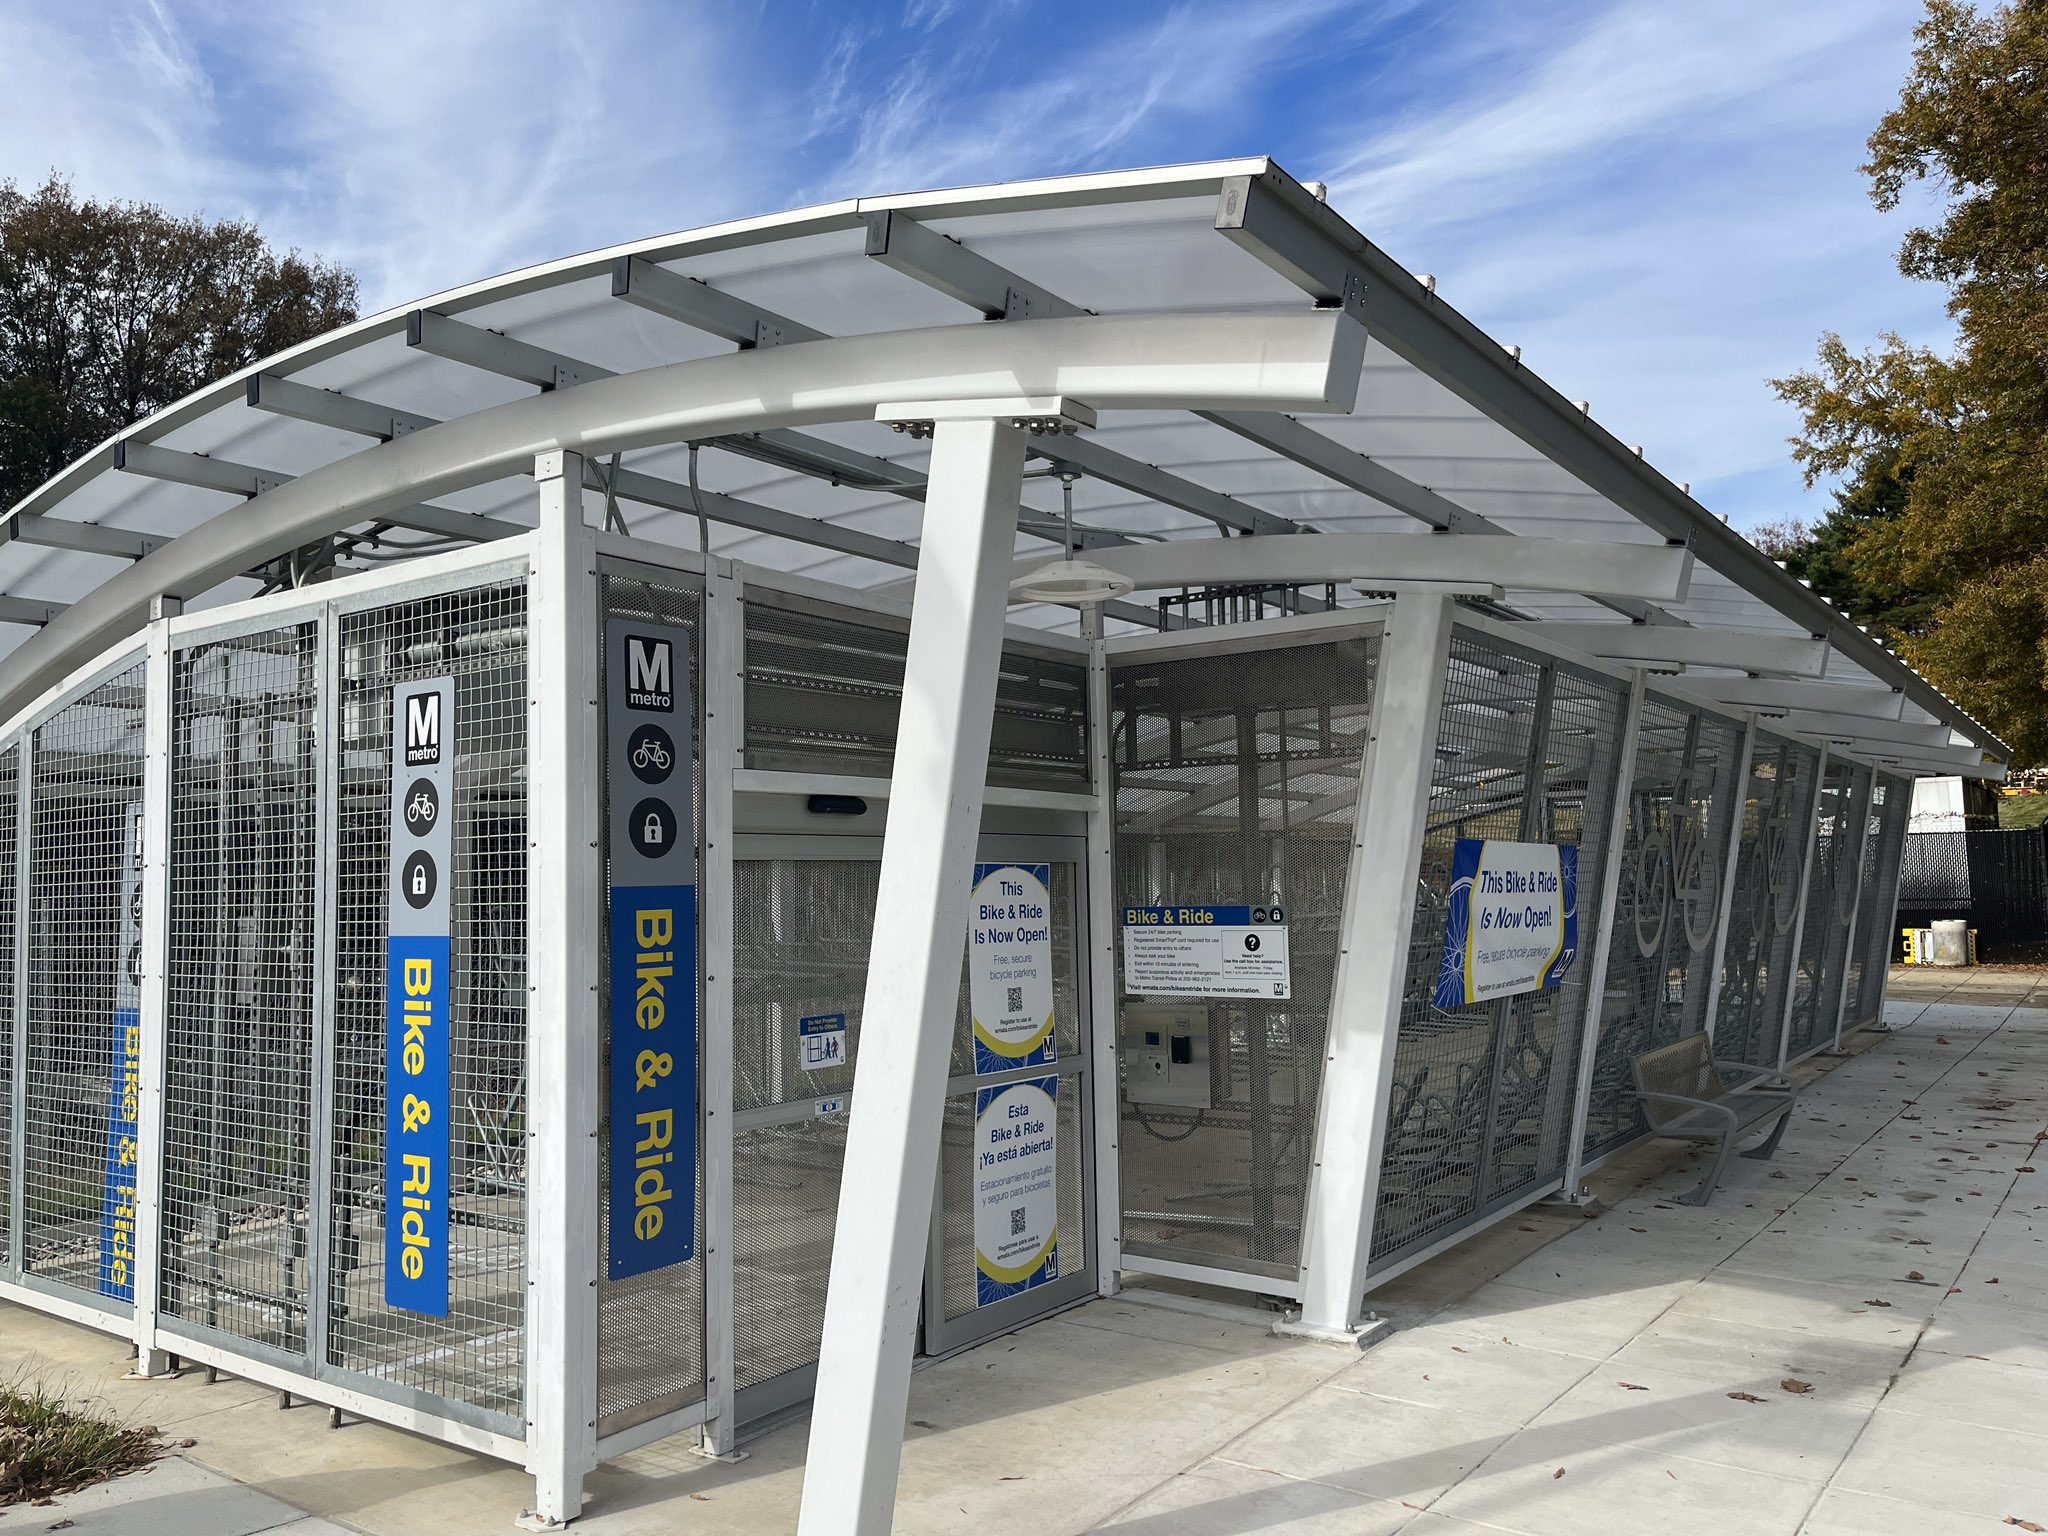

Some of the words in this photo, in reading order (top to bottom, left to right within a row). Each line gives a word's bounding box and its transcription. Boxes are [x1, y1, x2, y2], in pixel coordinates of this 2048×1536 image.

[629, 639, 670, 693] M
[630, 692, 670, 707] metro
[409, 696, 438, 747] M
[408, 746, 437, 761] metro
[1000, 881, 1023, 896] This
[1480, 871, 1502, 893] This
[1506, 871, 1526, 893] Bike
[1529, 871, 1535, 893] &
[1538, 872, 1557, 893] Ride
[980, 905, 1005, 920] Bike
[1008, 905, 1016, 919] &
[1019, 904, 1042, 919] Ride
[1127, 909, 1158, 924] Bike
[1164, 910, 1174, 924] &
[1179, 909, 1214, 924] Ride
[1480, 907, 1492, 929] Is
[1494, 907, 1522, 928] Now
[1525, 906, 1551, 932] Open!
[975, 929, 985, 944] Is
[989, 929, 1013, 943] Now
[1017, 926, 1047, 945] Open!
[1249, 937, 1256, 948] ?
[994, 955, 1009, 965] Free,
[1011, 955, 1032, 963] secure
[1477, 950, 1491, 964] Free,
[1491, 949, 1506, 961] secure
[1506, 947, 1527, 960] bicycle
[1526, 945, 1550, 959] parking
[1556, 951, 1572, 970] M
[636, 909, 672, 1030] Bike
[990, 970, 1012, 981] bicycle
[1014, 968, 1036, 980] parking
[1275, 984, 1282, 992] M
[403, 959, 431, 1076] Bike
[1044, 1037, 1053, 1053] M
[635, 1049, 672, 1093] &
[402, 1093, 430, 1133] &
[1008, 1104, 1029, 1118] Esta
[991, 1128, 1012, 1143] Bike
[1015, 1125, 1021, 1137] &
[1024, 1120, 1044, 1136] Ride
[980, 1151, 994, 1170] ¡Ya
[997, 1145, 1017, 1163] está
[1020, 1137, 1053, 1157] abierta!
[634, 1109, 672, 1241] Ride
[980, 1172, 1030, 1191] Estacionamiento
[1031, 1165, 1052, 1179] gratuito
[982, 1198, 986, 1207] y
[988, 1191, 1009, 1205] seguro
[1010, 1188, 1024, 1200] para
[1025, 1179, 1051, 1194] bicicletas
[401, 1153, 430, 1280] Ride
[1046, 1254, 1055, 1271] M
